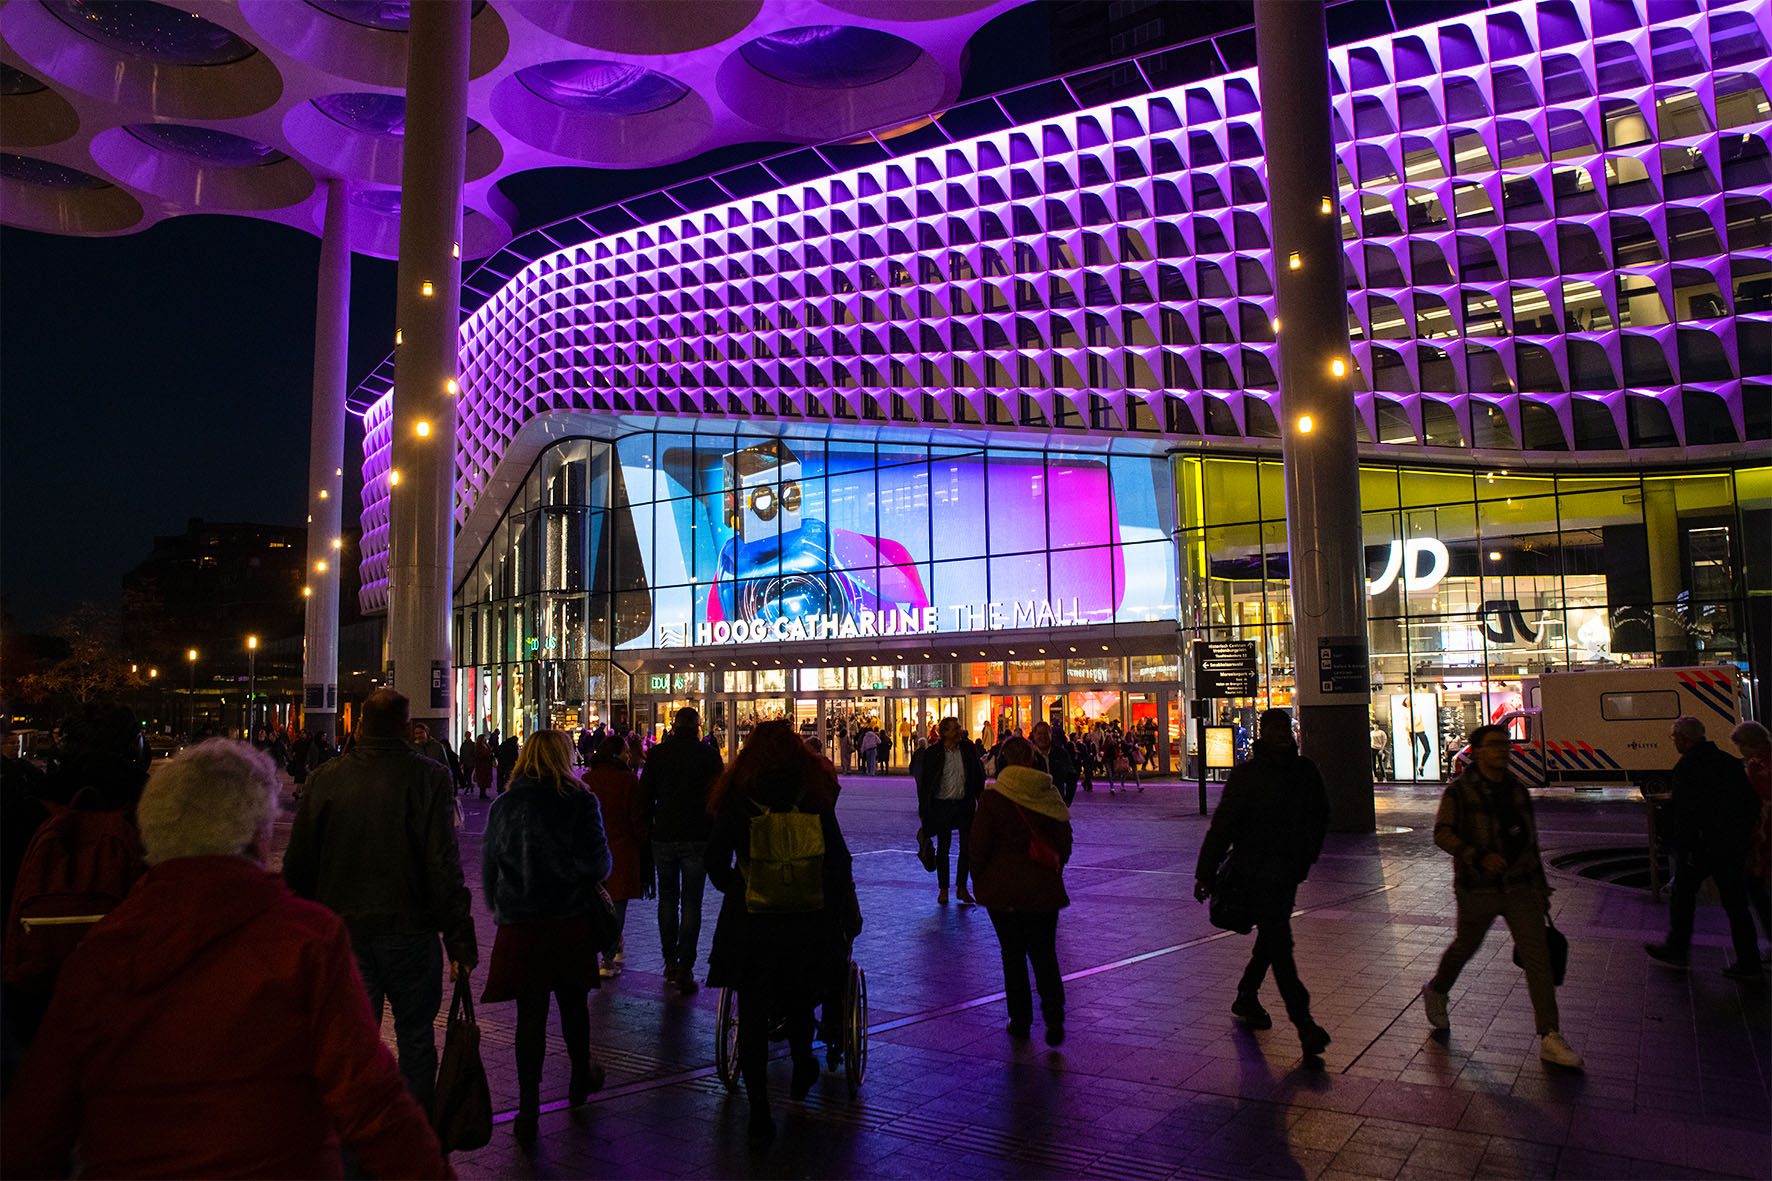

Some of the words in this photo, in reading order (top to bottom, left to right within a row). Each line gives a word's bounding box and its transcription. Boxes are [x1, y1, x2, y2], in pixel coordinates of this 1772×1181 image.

[1370, 537, 1449, 596] JD
[695, 619, 768, 647] HOOG
[949, 602, 1010, 632] THE
[1013, 597, 1089, 628] MALL
